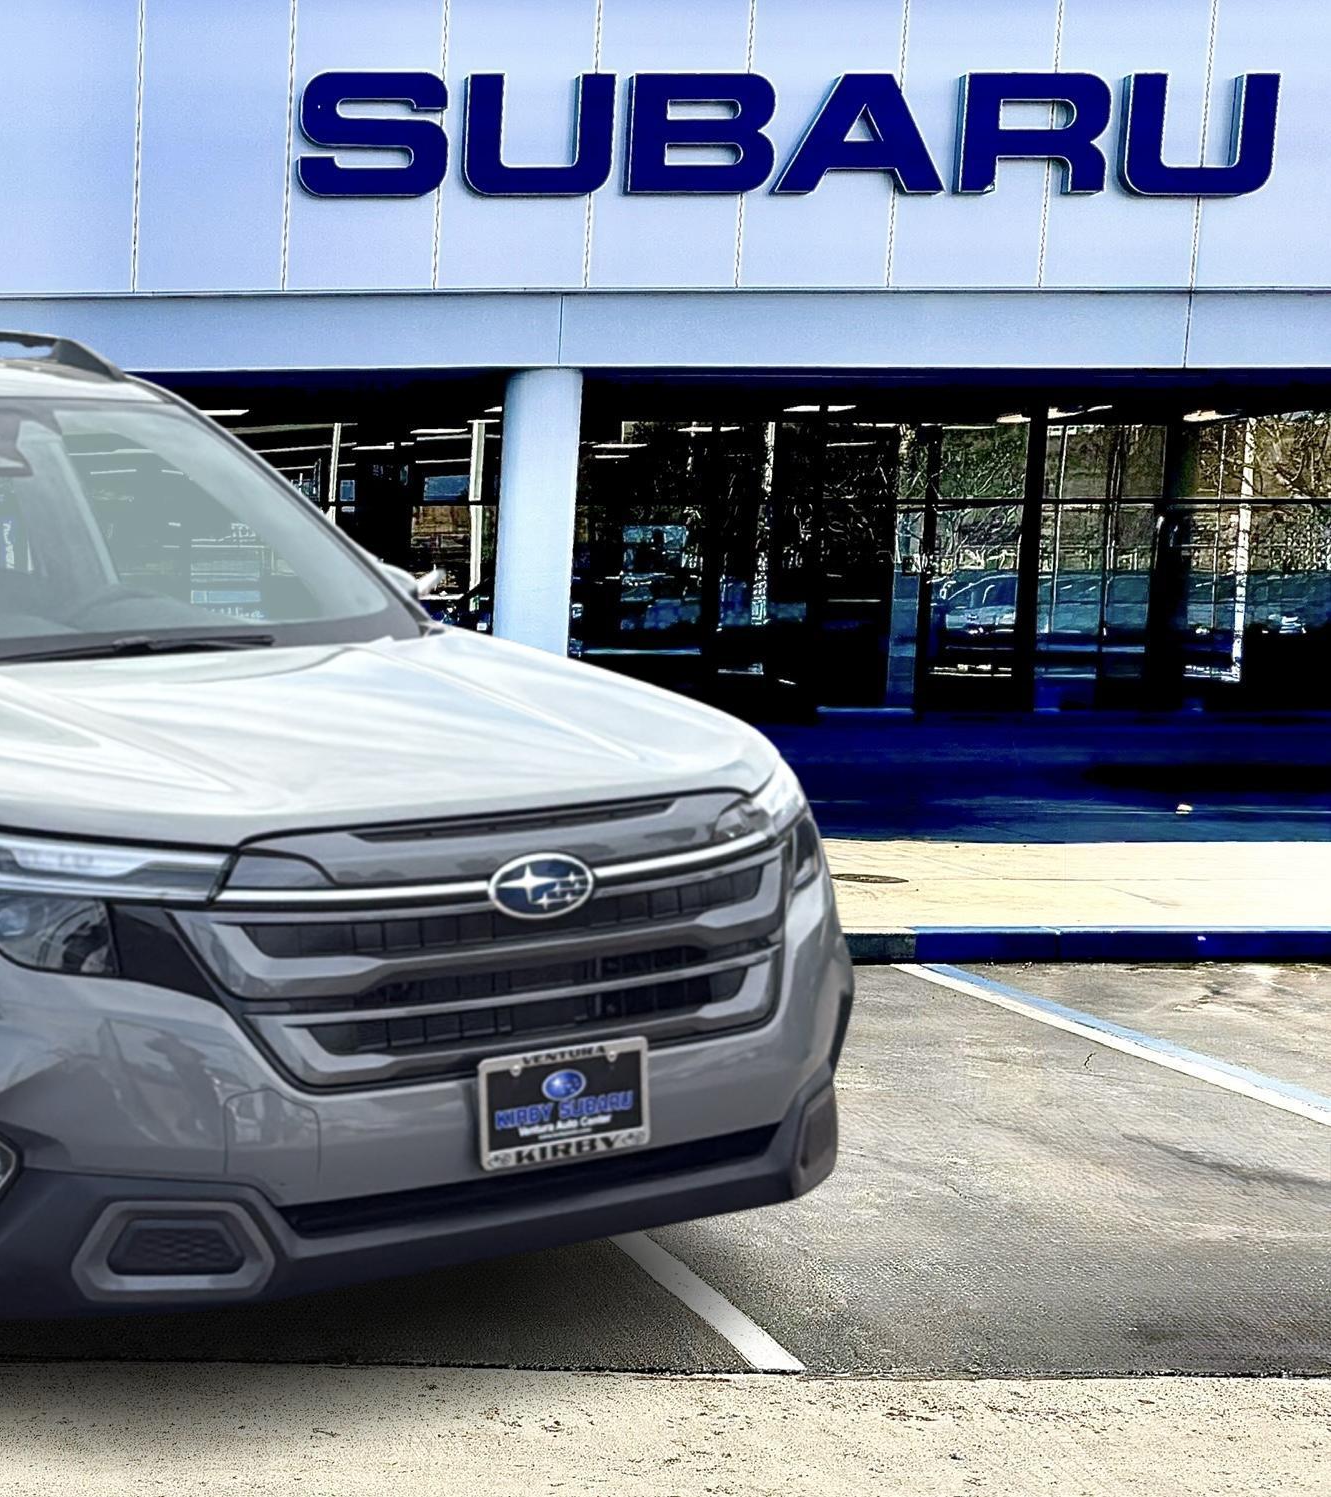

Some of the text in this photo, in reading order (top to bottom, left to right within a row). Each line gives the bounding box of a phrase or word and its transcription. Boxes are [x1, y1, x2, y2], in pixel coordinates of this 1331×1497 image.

[296, 71, 1281, 199] SUBARU
[522, 1045, 606, 1065] VENTURA
[495, 1091, 634, 1129] KIRBY SUBARU
[556, 1118, 578, 1129] Auto
[580, 1113, 612, 1127] Center
[515, 1134, 619, 1164] KIRBY
